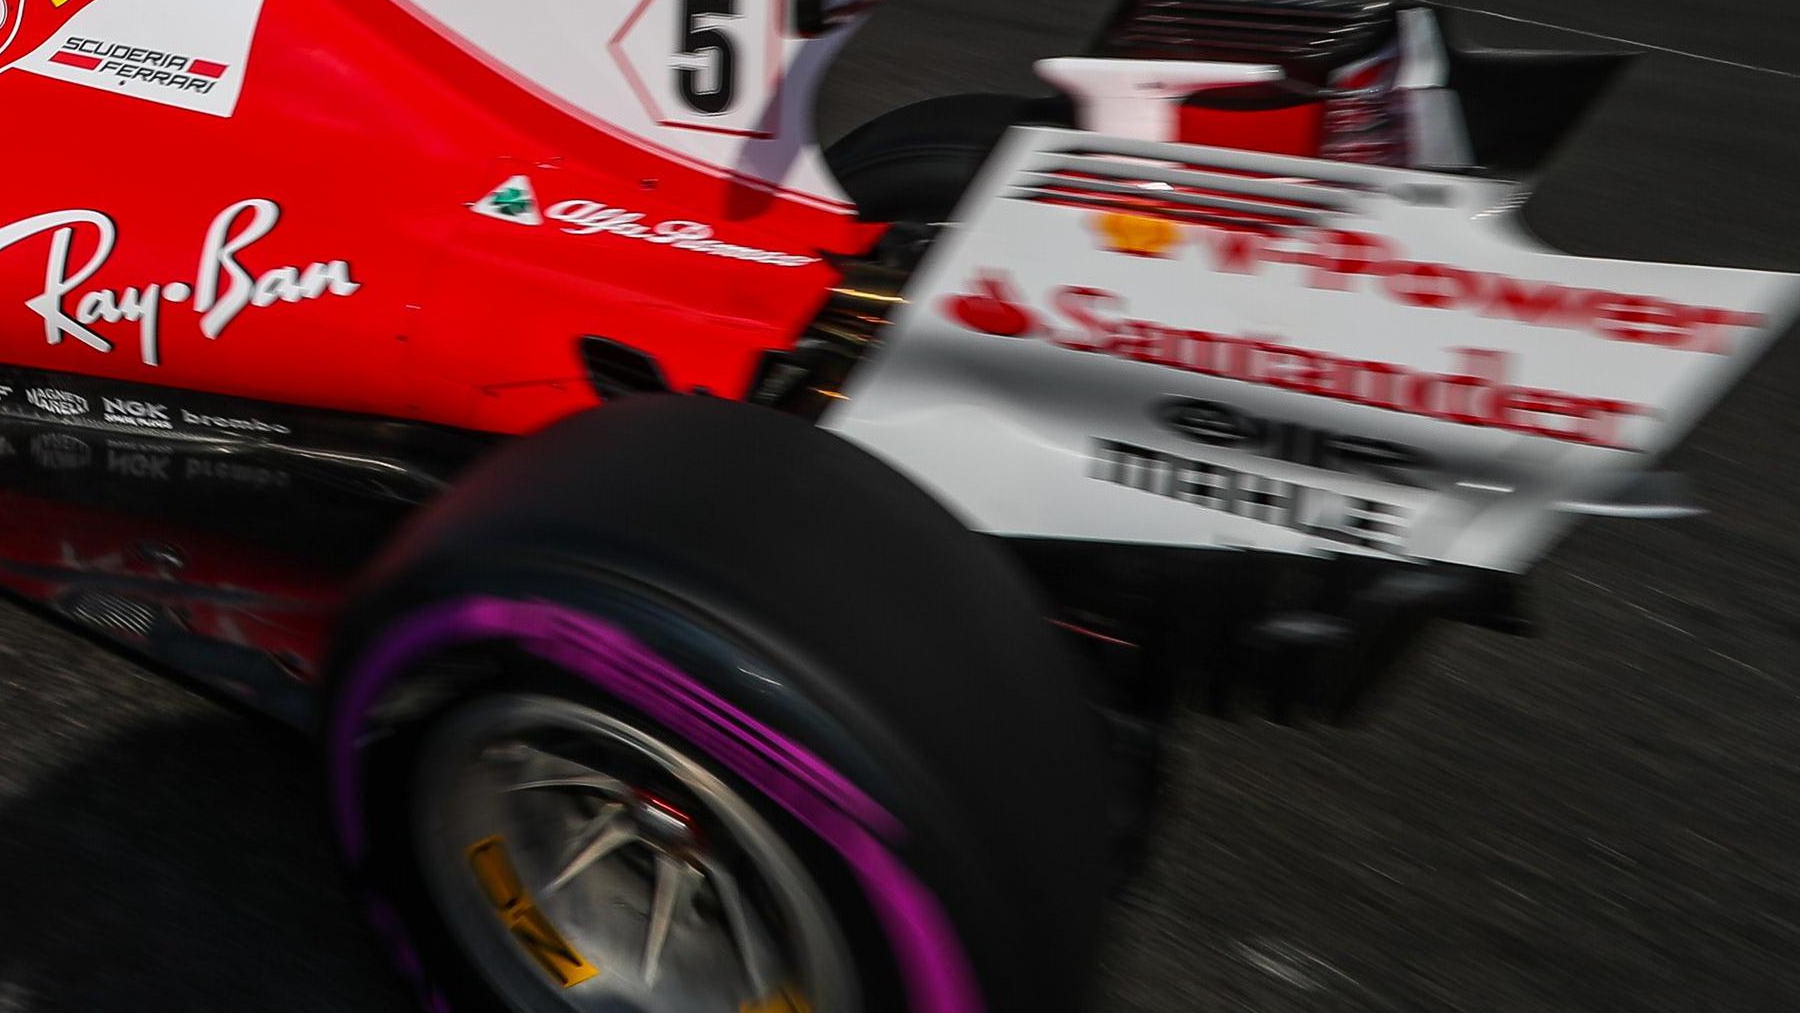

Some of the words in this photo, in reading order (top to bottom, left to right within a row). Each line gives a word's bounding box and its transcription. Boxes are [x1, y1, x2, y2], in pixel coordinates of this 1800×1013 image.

[62, 36, 189, 71] SCUDERIA
[99, 60, 216, 94] FERRARI
[101, 396, 170, 420] NGK
